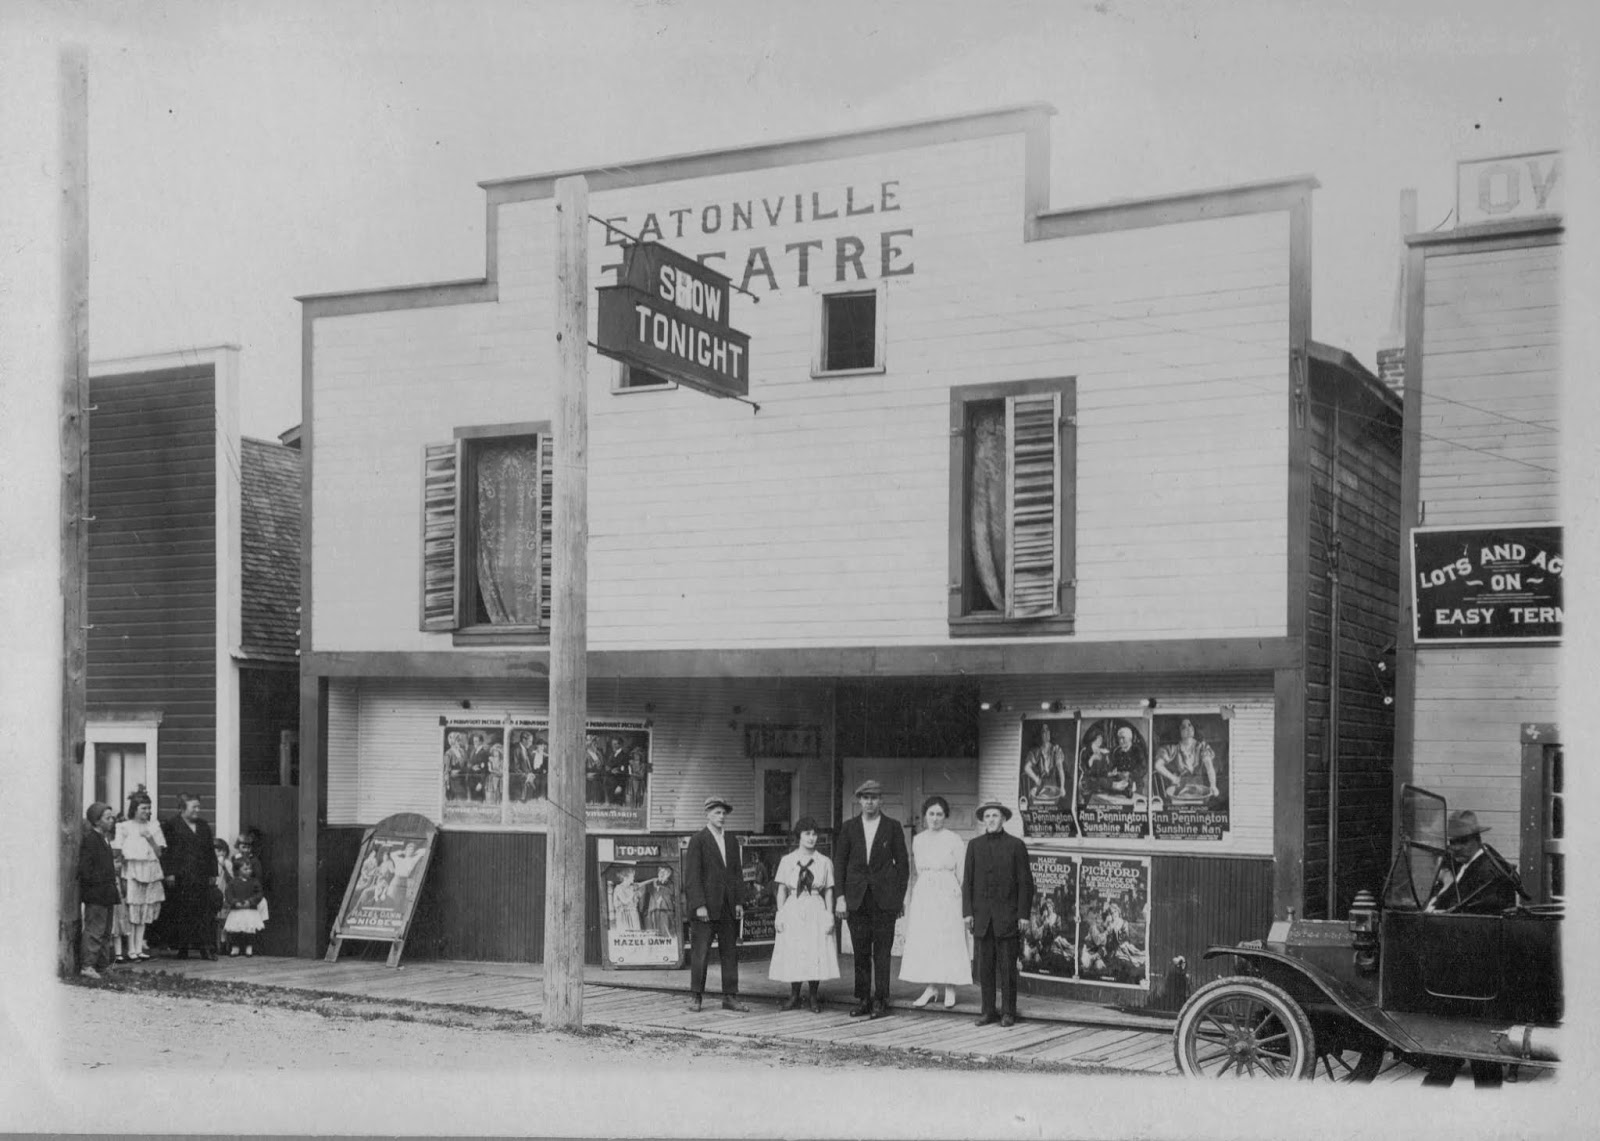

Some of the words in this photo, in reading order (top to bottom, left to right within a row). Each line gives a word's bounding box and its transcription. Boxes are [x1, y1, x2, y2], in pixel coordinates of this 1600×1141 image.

[605, 181, 901, 247] EATONVILLE
[635, 304, 743, 379] TONIGHT
[1420, 558, 1472, 588] LOTS
[1480, 544, 1526, 566] AND
[1491, 574, 1522, 591] ON
[1436, 608, 1495, 625] EASY
[1079, 810, 1095, 821] Ann
[1097, 810, 1148, 825] Pennington
[1152, 812, 1168, 822] Ann
[1171, 812, 1228, 825] Pennington
[1030, 861, 1071, 874] ICKFORD
[1037, 856, 1057, 864] MARY
[1082, 865, 1140, 878] PICKFORD
[614, 938, 645, 947] HAZEL
[648, 938, 672, 946] DAWN
